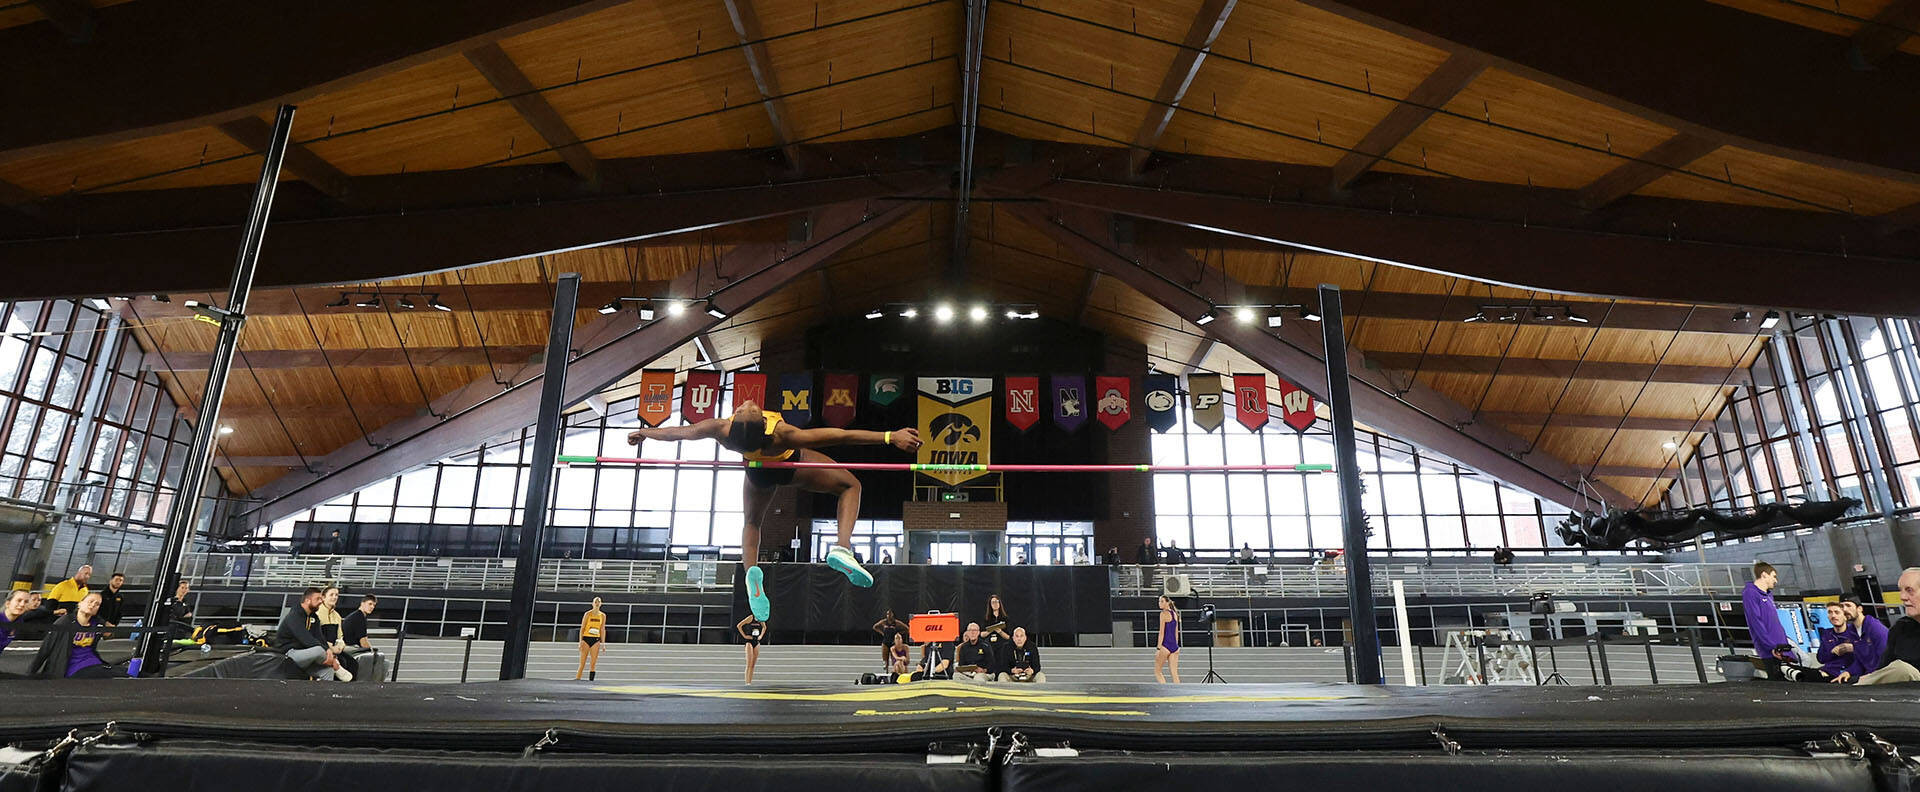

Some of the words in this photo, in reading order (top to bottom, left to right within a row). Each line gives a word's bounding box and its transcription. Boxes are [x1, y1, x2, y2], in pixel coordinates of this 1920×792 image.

[782, 390, 809, 410] M
[825, 388, 854, 407] M
[1010, 390, 1034, 413] N
[1195, 393, 1220, 410] P
[1240, 386, 1265, 413] R
[1284, 389, 1310, 416] W
[930, 450, 978, 465] IOWA
[925, 624, 944, 632] GILL
